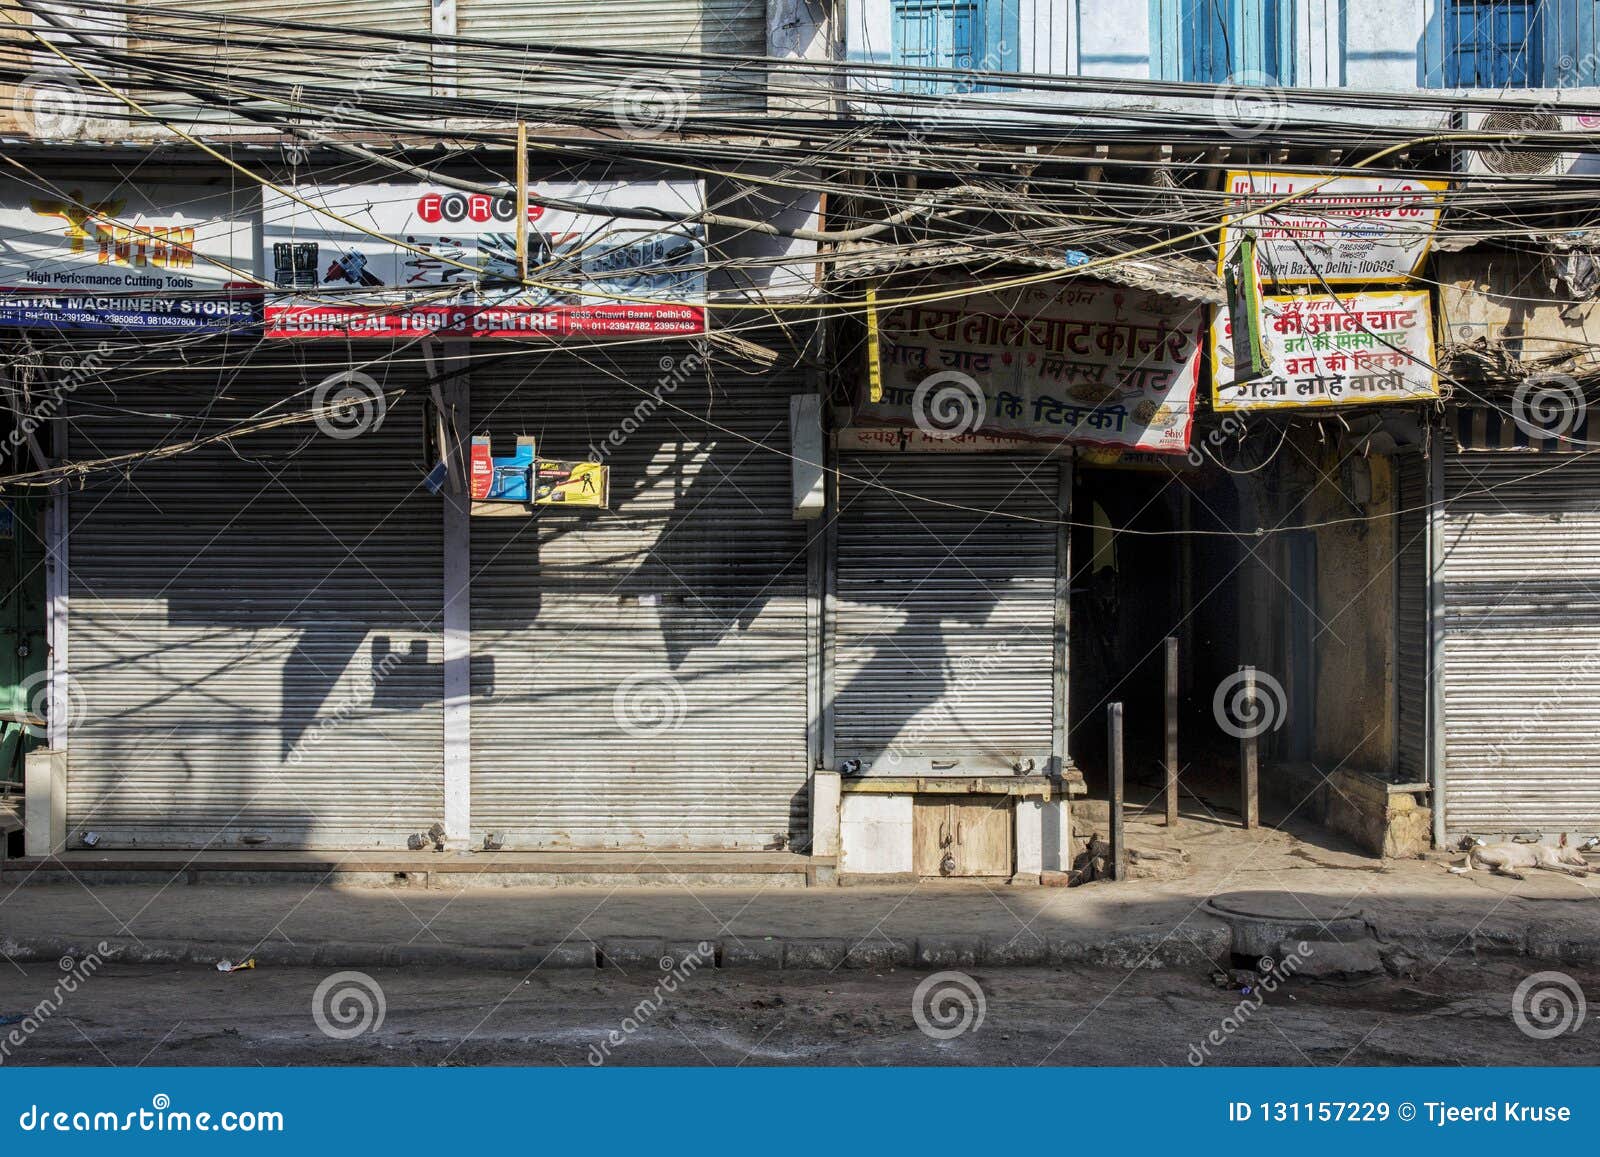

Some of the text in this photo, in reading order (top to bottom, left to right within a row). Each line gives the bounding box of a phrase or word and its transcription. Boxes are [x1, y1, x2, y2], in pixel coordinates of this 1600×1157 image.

[1339, 243, 1376, 251] PRESSURE
[27, 271, 194, 289] High Performance Cutting Tools
[0, 297, 254, 316] ENTAL MACHINERY STORES
[595, 310, 626, 320] Chawri
[627, 310, 655, 320] Bazar,
[656, 310, 692, 320] Delhi-06
[271, 311, 559, 332] TECHNICAL TOOLS CENTRE
[1366, 310, 1418, 331] चाट
[940, 349, 993, 372] चाट
[1284, 356, 1318, 375] व्रत
[1322, 351, 1347, 371] की
[1349, 368, 1406, 393] वाली
